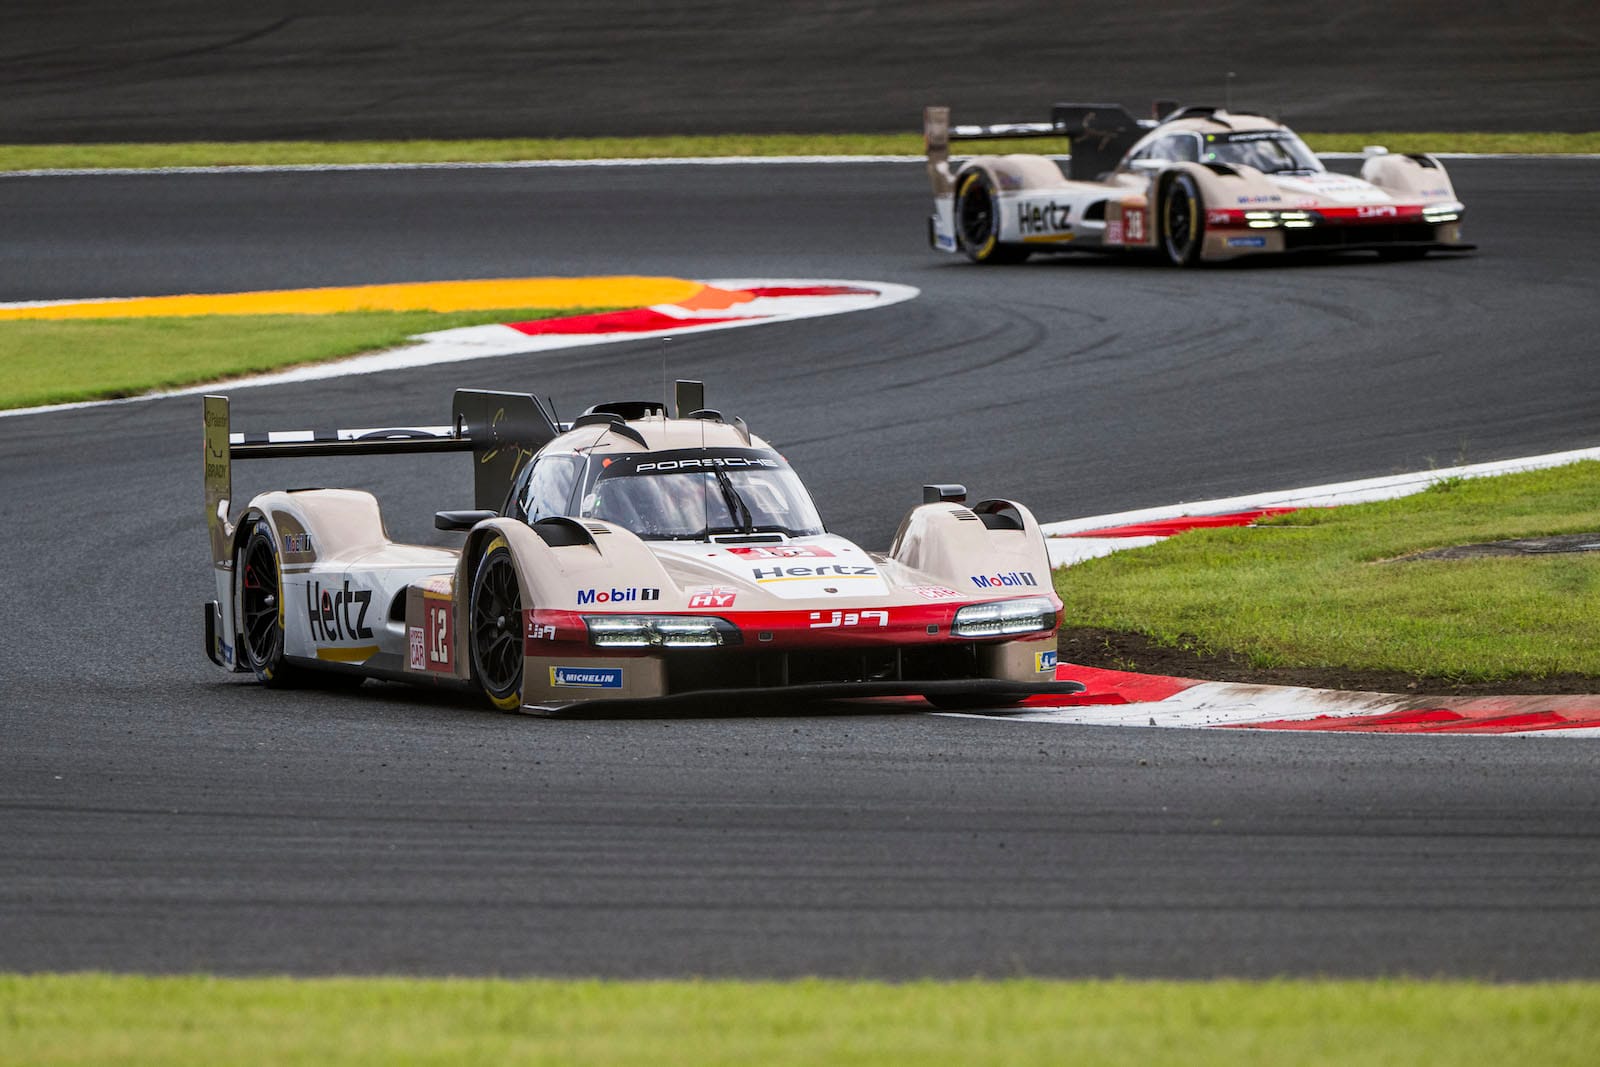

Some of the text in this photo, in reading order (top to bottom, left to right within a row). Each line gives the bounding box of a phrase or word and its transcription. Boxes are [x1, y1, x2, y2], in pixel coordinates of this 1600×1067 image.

[1018, 201, 1072, 234] Hertz
[635, 457, 778, 472] PORSCHE
[752, 564, 877, 580] Hertz
[971, 572, 1034, 588] Mobil 1
[577, 588, 657, 605] Mobil 1
[690, 594, 734, 607] HY
[306, 580, 373, 642] Hertz
[430, 607, 448, 664] 12
[411, 643, 425, 668] CAR
[565, 673, 614, 684] MICHELIN
